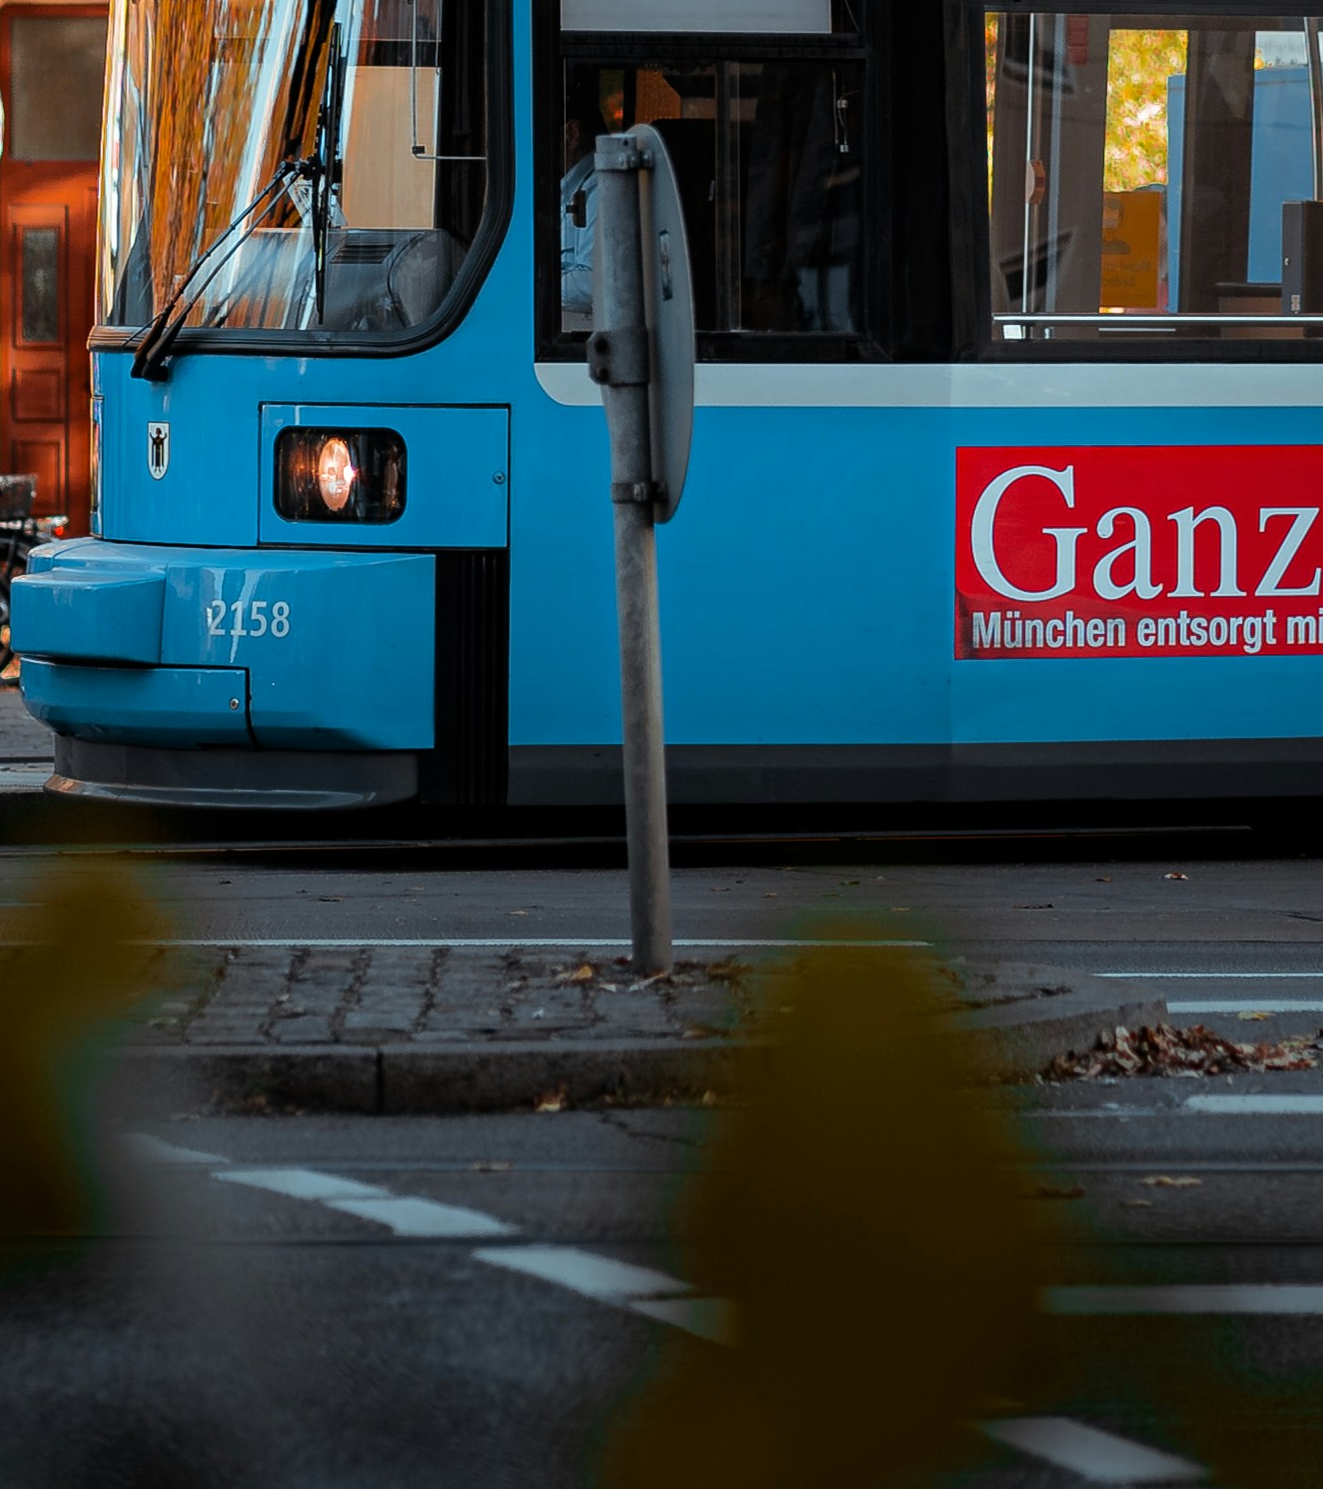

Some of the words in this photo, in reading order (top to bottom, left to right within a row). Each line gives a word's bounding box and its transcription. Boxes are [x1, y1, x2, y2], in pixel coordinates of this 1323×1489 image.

[970, 464, 1323, 602] Ganz
[208, 599, 290, 638] 2158
[971, 608, 1127, 650] München
[1136, 609, 1278, 655] entsorgt
